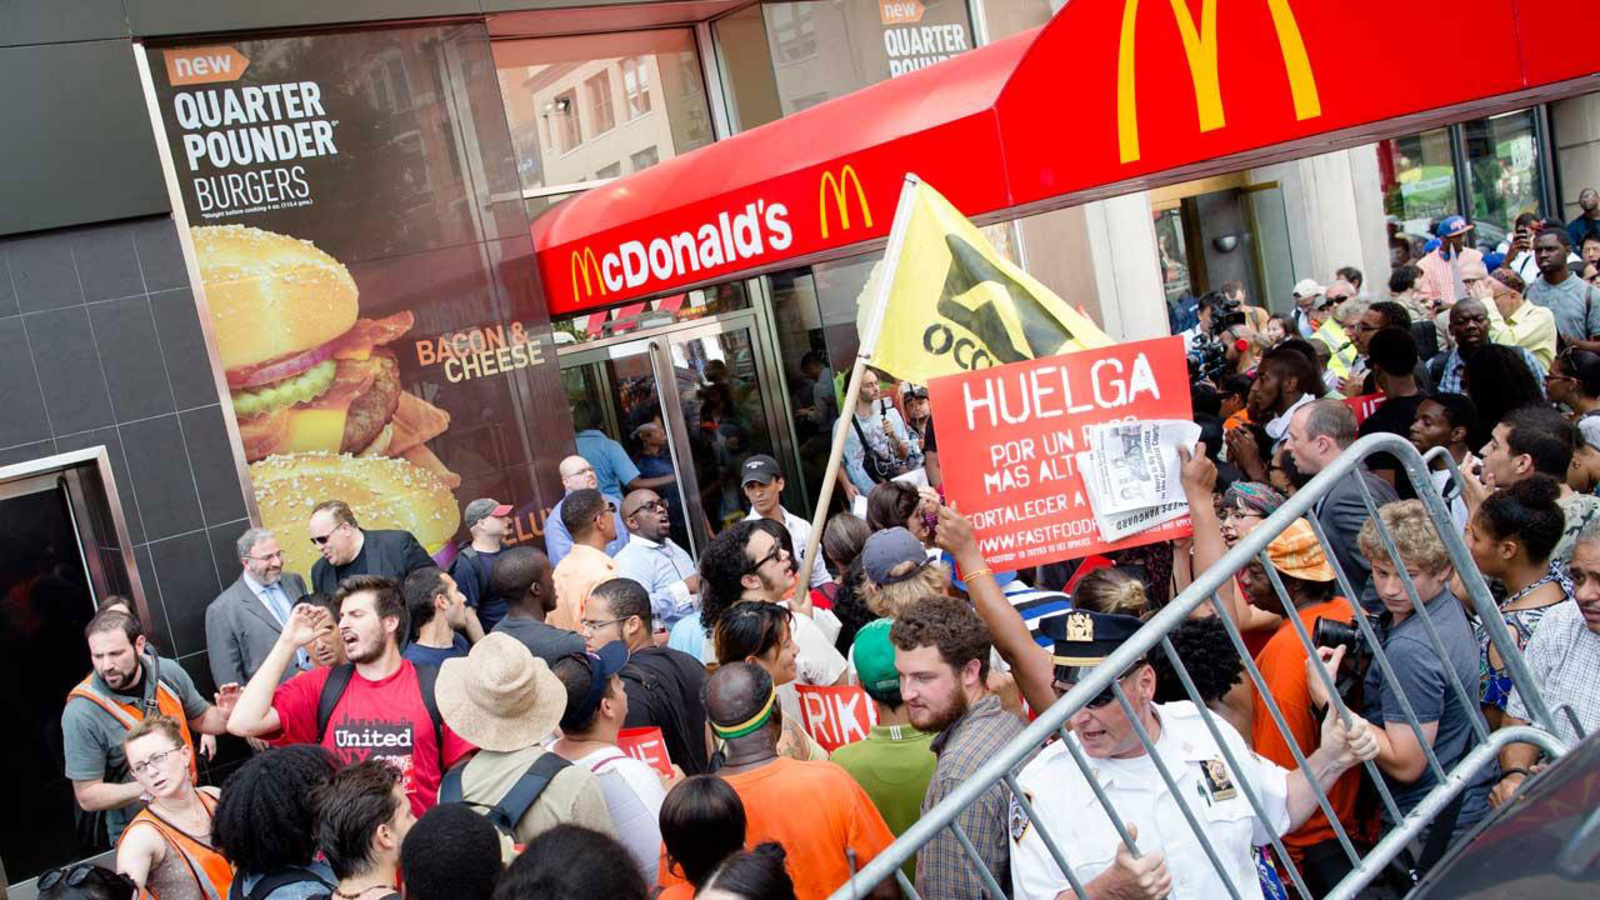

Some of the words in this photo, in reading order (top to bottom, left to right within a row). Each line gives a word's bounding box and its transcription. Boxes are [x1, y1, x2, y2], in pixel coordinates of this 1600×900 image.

[884, 3, 917, 19] new
[883, 23, 968, 57] QUARTER
[174, 54, 232, 78] new
[173, 80, 326, 130] QUARTER
[193, 165, 311, 212] BURGERS
[570, 199, 794, 303] McDonald's
[415, 324, 507, 367] BACON
[511, 321, 531, 346] &
[444, 339, 546, 384] CHEESE
[963, 351, 1161, 431] HUELGA
[990, 437, 1036, 469] POR
[1042, 428, 1075, 456] UN
[1039, 453, 1076, 484] ALT
[1074, 490, 1086, 508] A
[1115, 505, 1160, 531] VANGUARD
[334, 727, 413, 748] United
